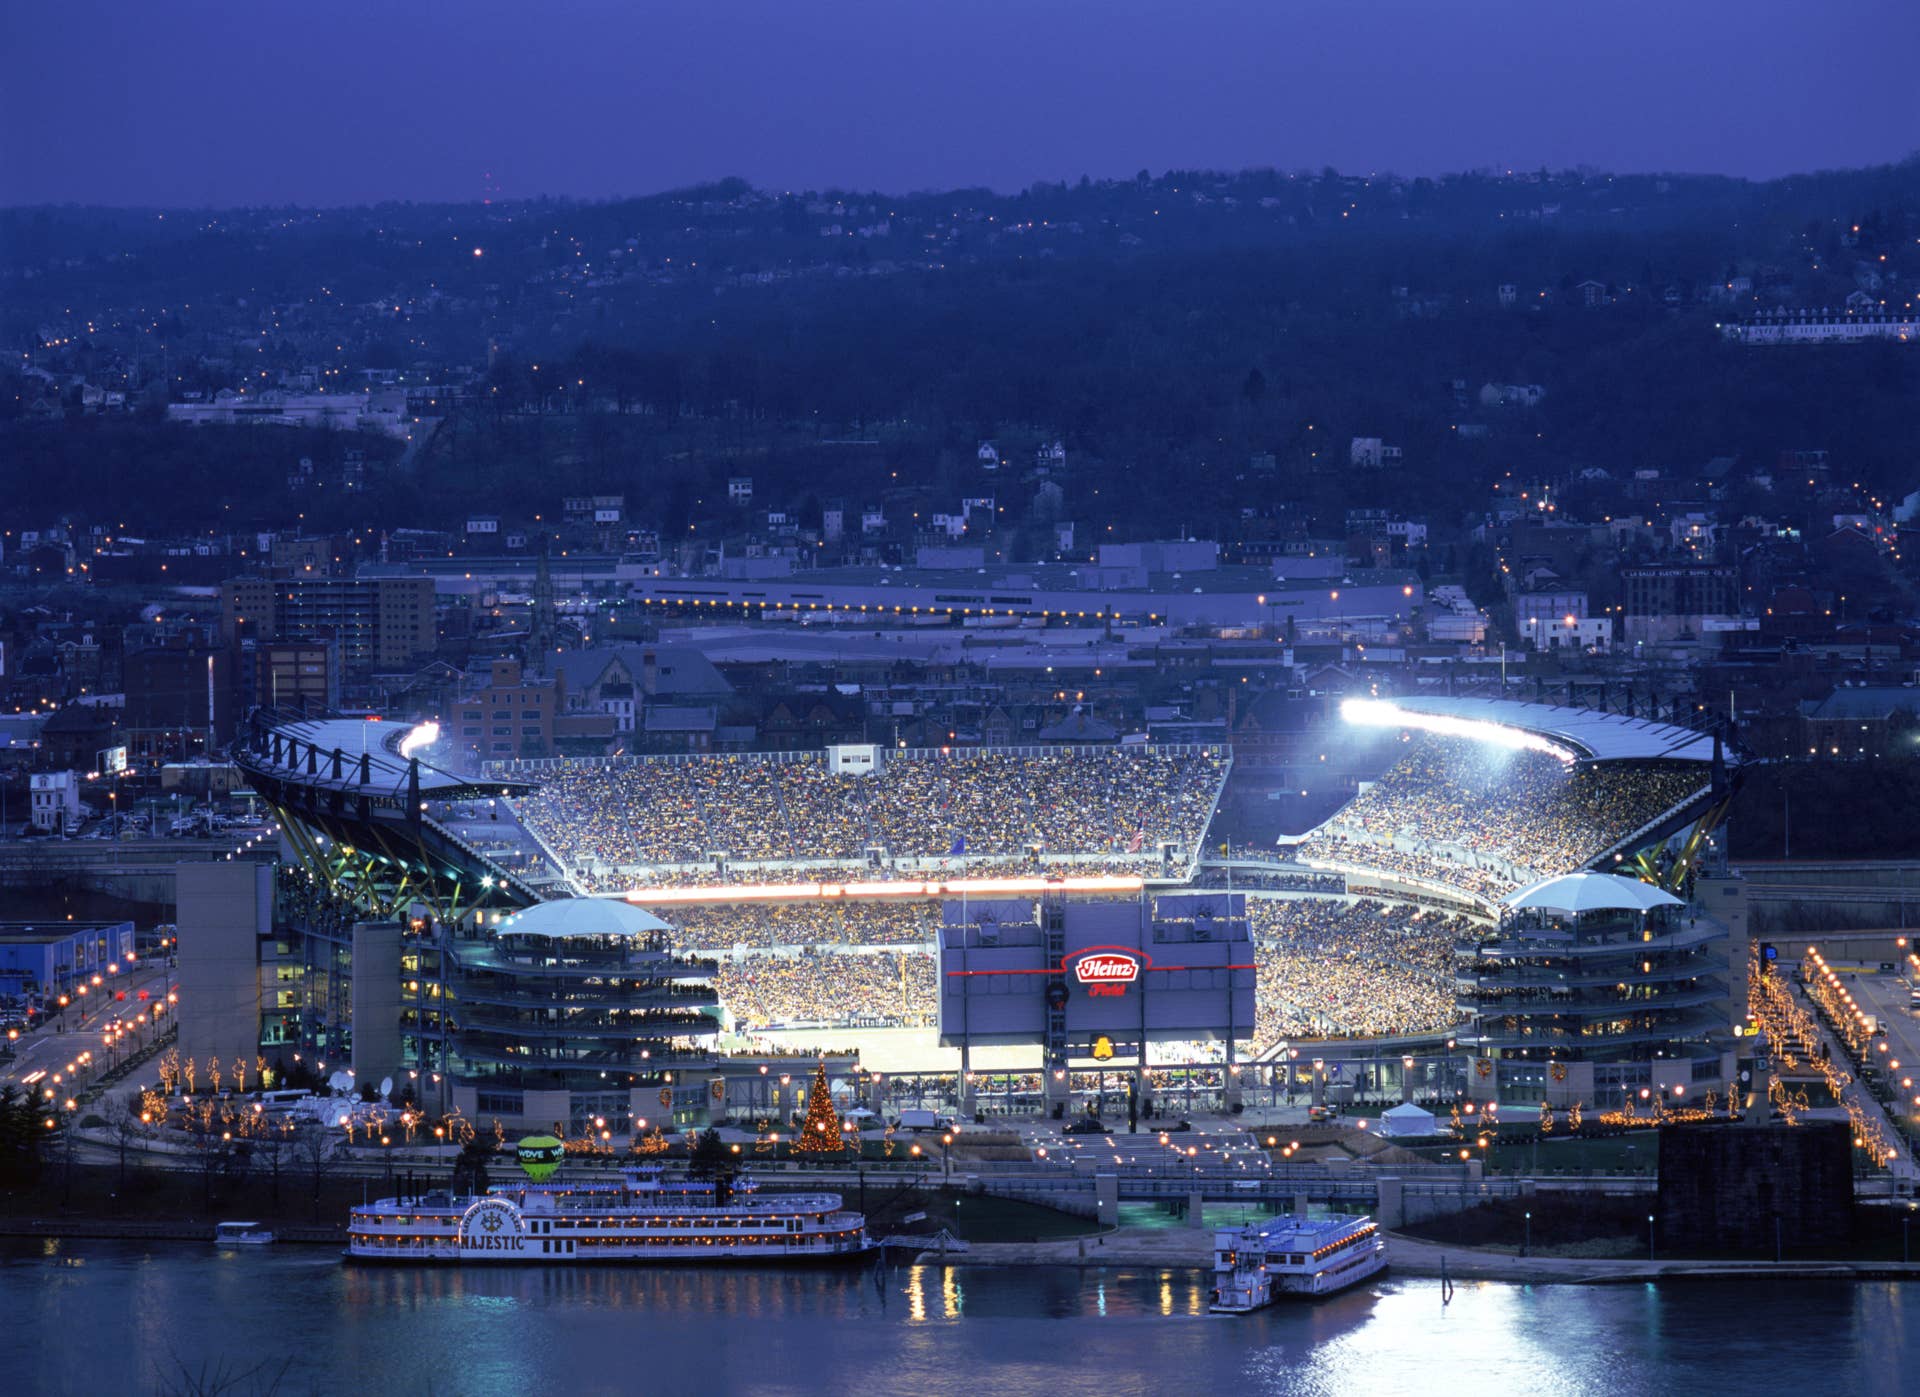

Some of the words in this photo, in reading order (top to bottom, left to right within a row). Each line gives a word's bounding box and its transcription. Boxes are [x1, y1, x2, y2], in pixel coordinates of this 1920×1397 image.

[1080, 960, 1134, 978] Heinz
[1088, 983, 1126, 997] Field
[1094, 1036, 1113, 1057] A
[518, 1149, 545, 1159] WDVE
[463, 1206, 481, 1234] GATEWAY
[481, 1203, 509, 1215] CLIPPER
[509, 1212, 521, 1233] FLEET
[460, 1235, 525, 1250] MAJESTIC
